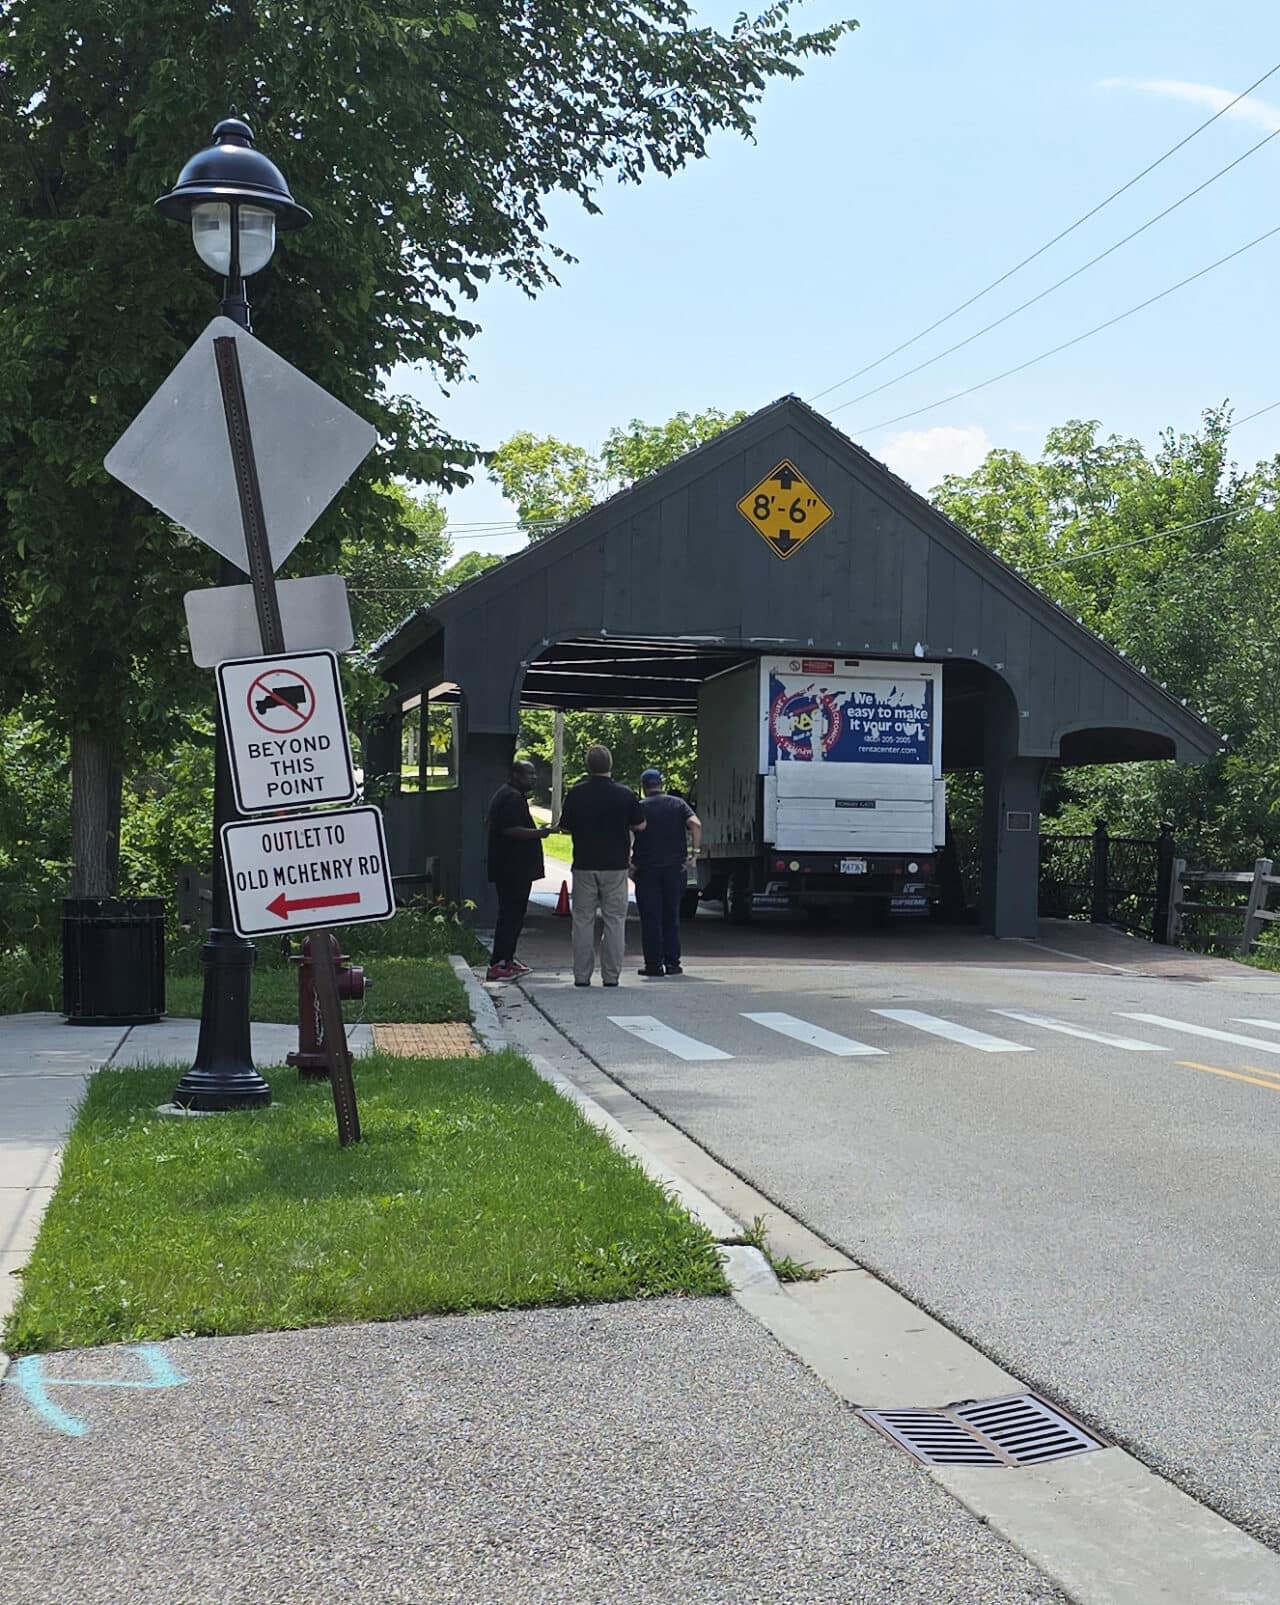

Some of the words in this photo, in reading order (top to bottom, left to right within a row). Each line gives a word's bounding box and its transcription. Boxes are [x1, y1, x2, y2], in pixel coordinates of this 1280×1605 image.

[847, 708, 875, 720] easy
[878, 707, 892, 718] to
[894, 708, 928, 719] make
[863, 721, 892, 732] your
[248, 735, 331, 759] BEYOND
[858, 746, 917, 754] rentacenter.com
[270, 758, 315, 777] THIS
[267, 776, 325, 798] POINT
[261, 826, 323, 853] OUTLET
[325, 824, 345, 845] TO
[236, 869, 269, 891] OLD
[274, 858, 353, 888] MCHENRY
[359, 855, 380, 876] RD
